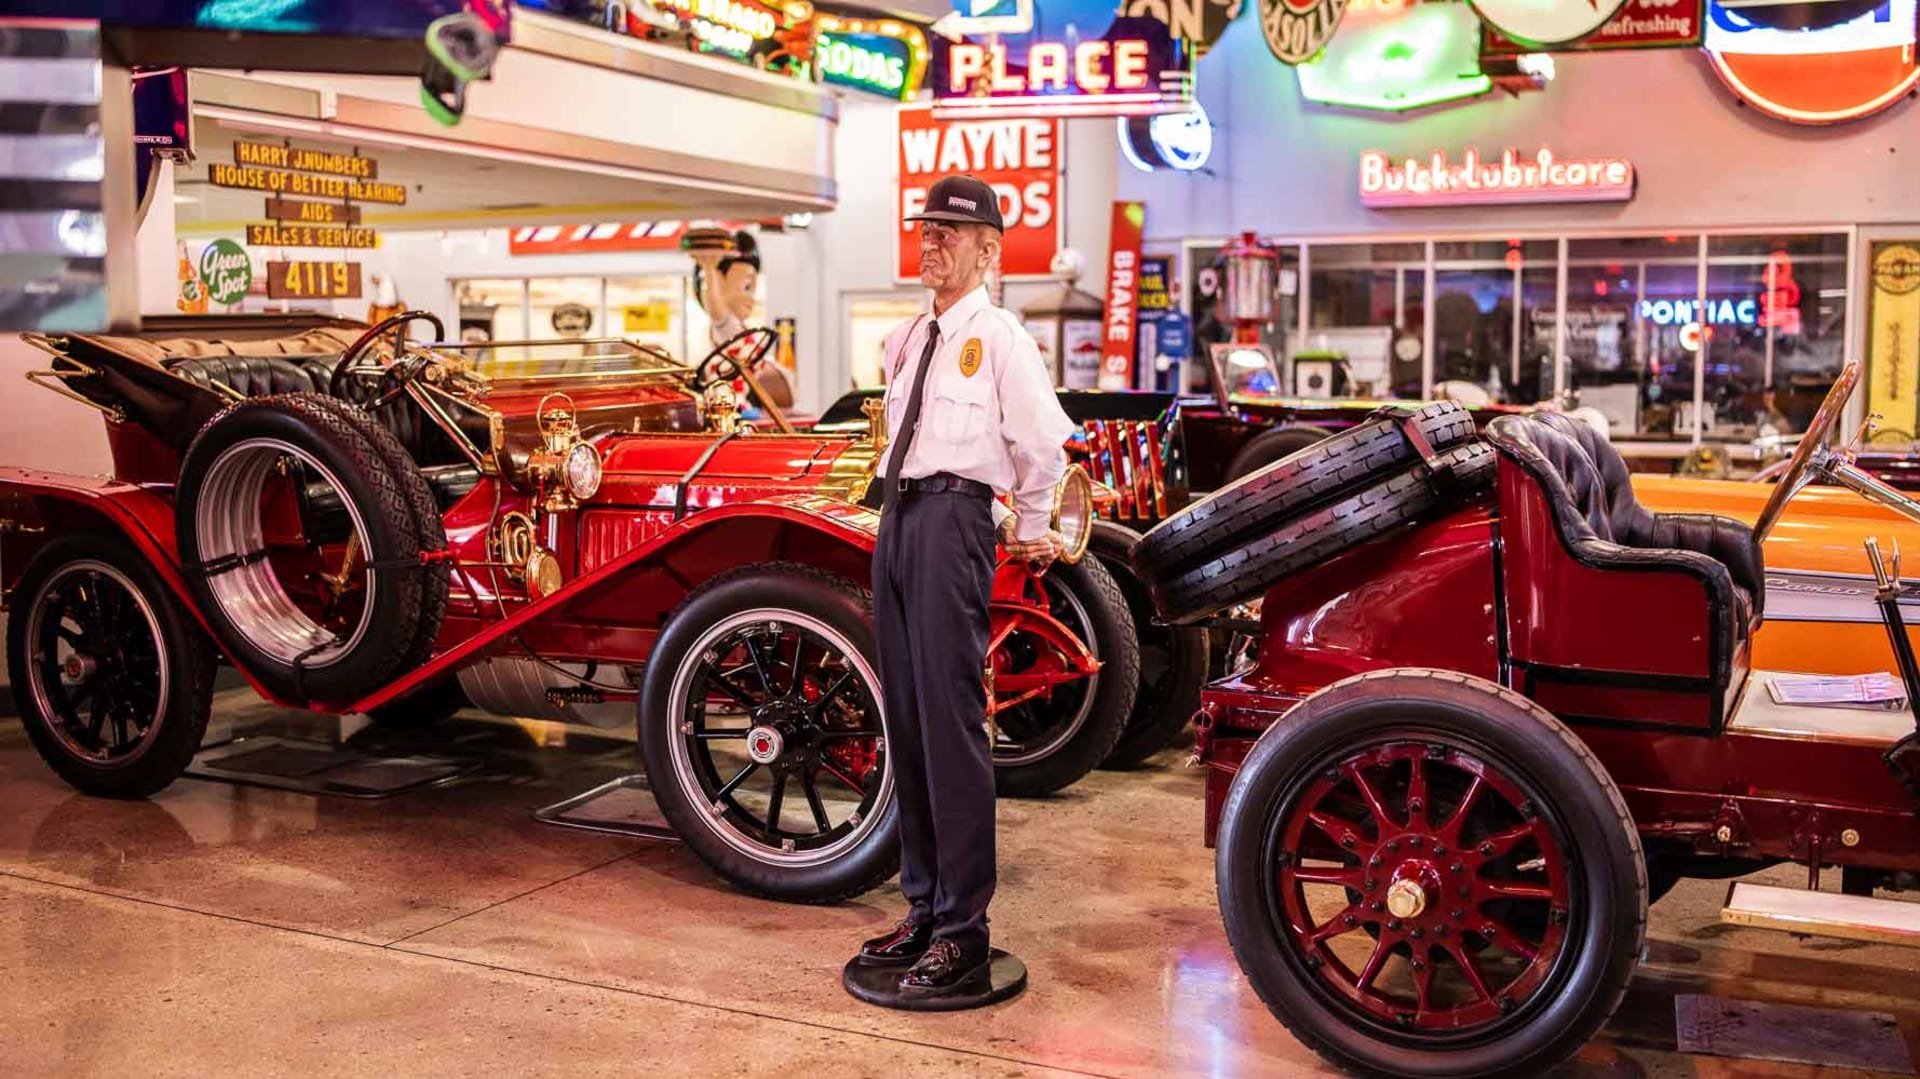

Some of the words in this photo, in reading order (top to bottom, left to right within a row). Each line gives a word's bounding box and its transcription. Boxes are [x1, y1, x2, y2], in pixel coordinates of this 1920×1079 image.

[816, 34, 904, 90] SODAS
[949, 39, 1150, 93] PLACE
[240, 143, 289, 167] HARRY
[901, 118, 1052, 174] WAYNE
[216, 166, 265, 188] HOUSE
[269, 171, 289, 189] OF
[292, 175, 345, 197] BETTER
[351, 180, 404, 202] HEARING
[301, 203, 334, 221] AIDS
[903, 182, 1052, 232] FDS
[303, 228, 313, 245] &
[317, 228, 374, 247] SERVICE
[202, 245, 249, 286] Green
[285, 262, 349, 297] 4119
[213, 271, 249, 301] Spot
[1108, 250, 1135, 341] BRAKE
[1635, 299, 1756, 325] PONTIAC
